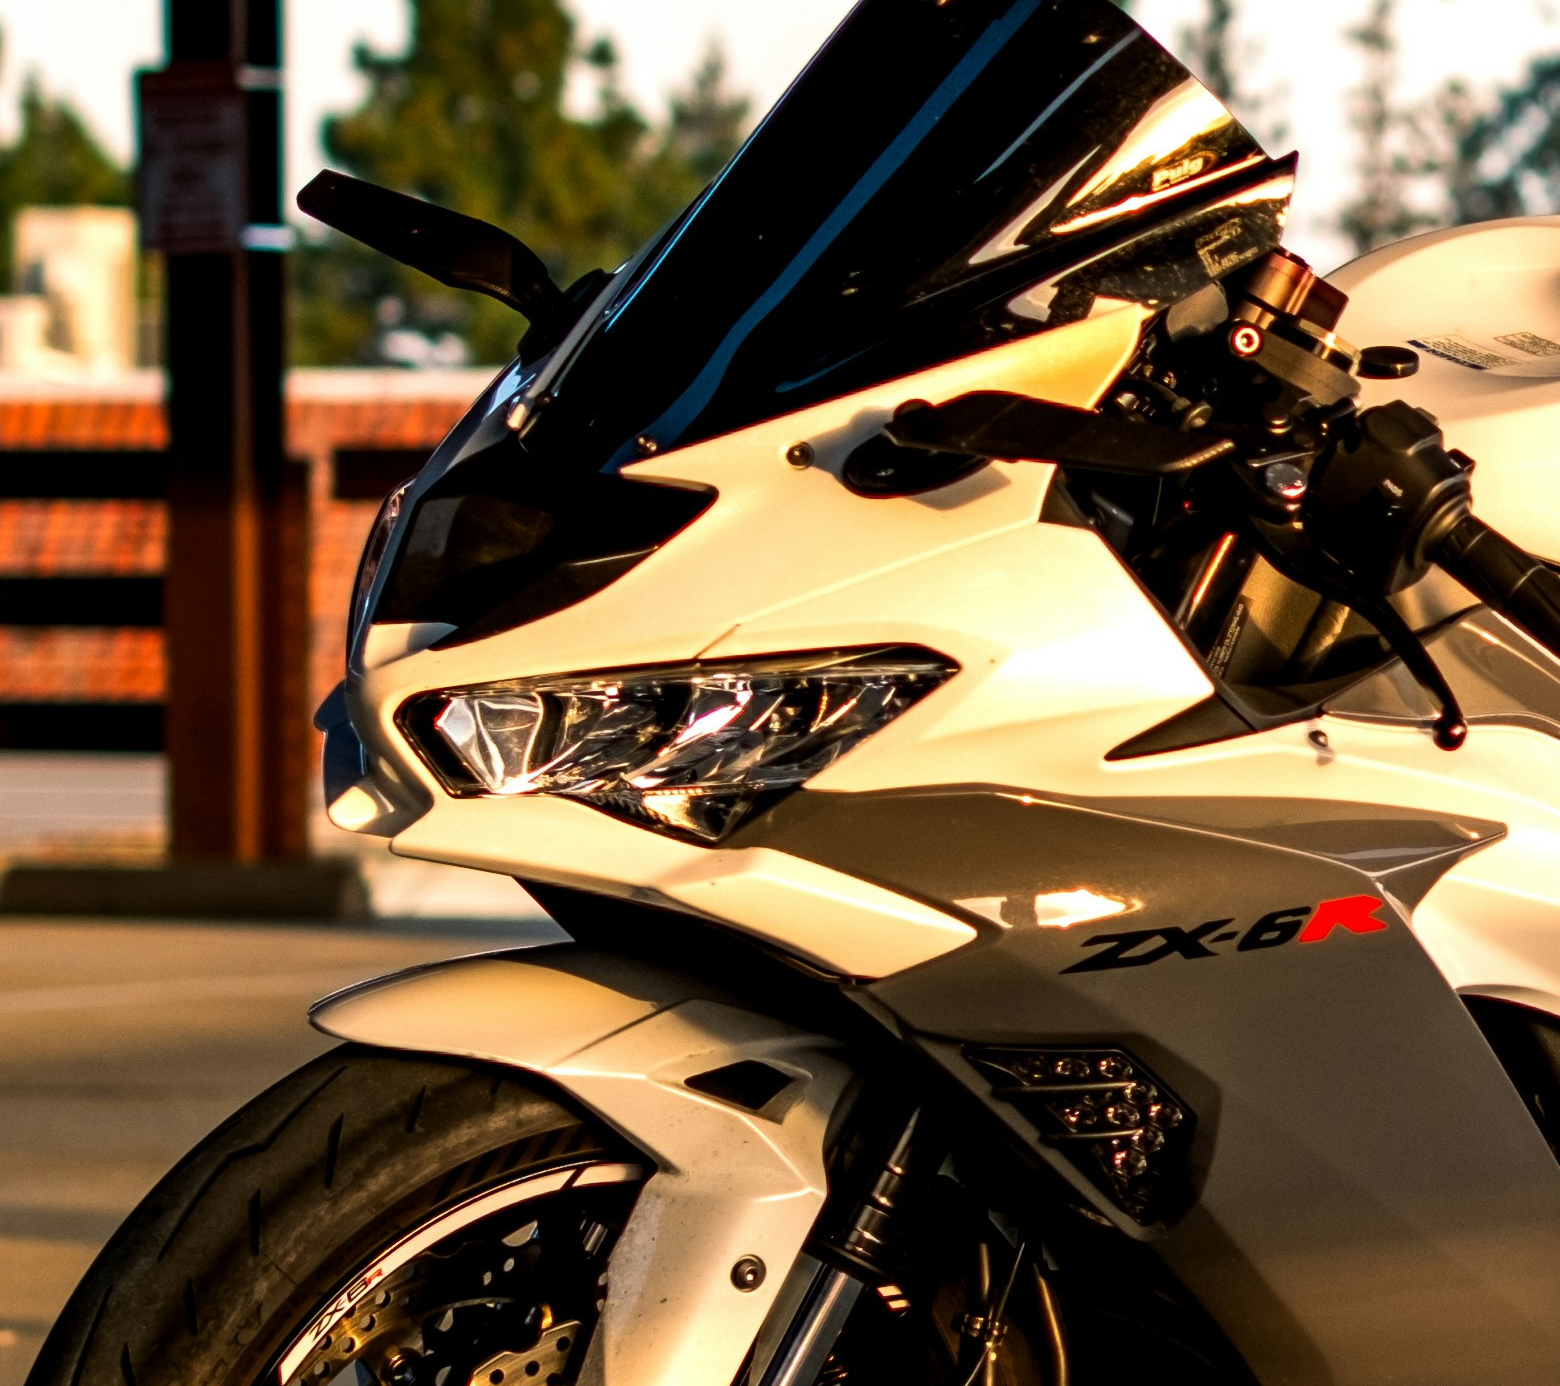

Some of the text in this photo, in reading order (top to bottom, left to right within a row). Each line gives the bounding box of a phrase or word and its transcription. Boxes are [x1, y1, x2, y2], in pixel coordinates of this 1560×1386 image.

[1151, 157, 1205, 190] Puig
[1059, 895, 1387, 974] ZX-6R
[311, 1268, 384, 1339] ZX-6R
